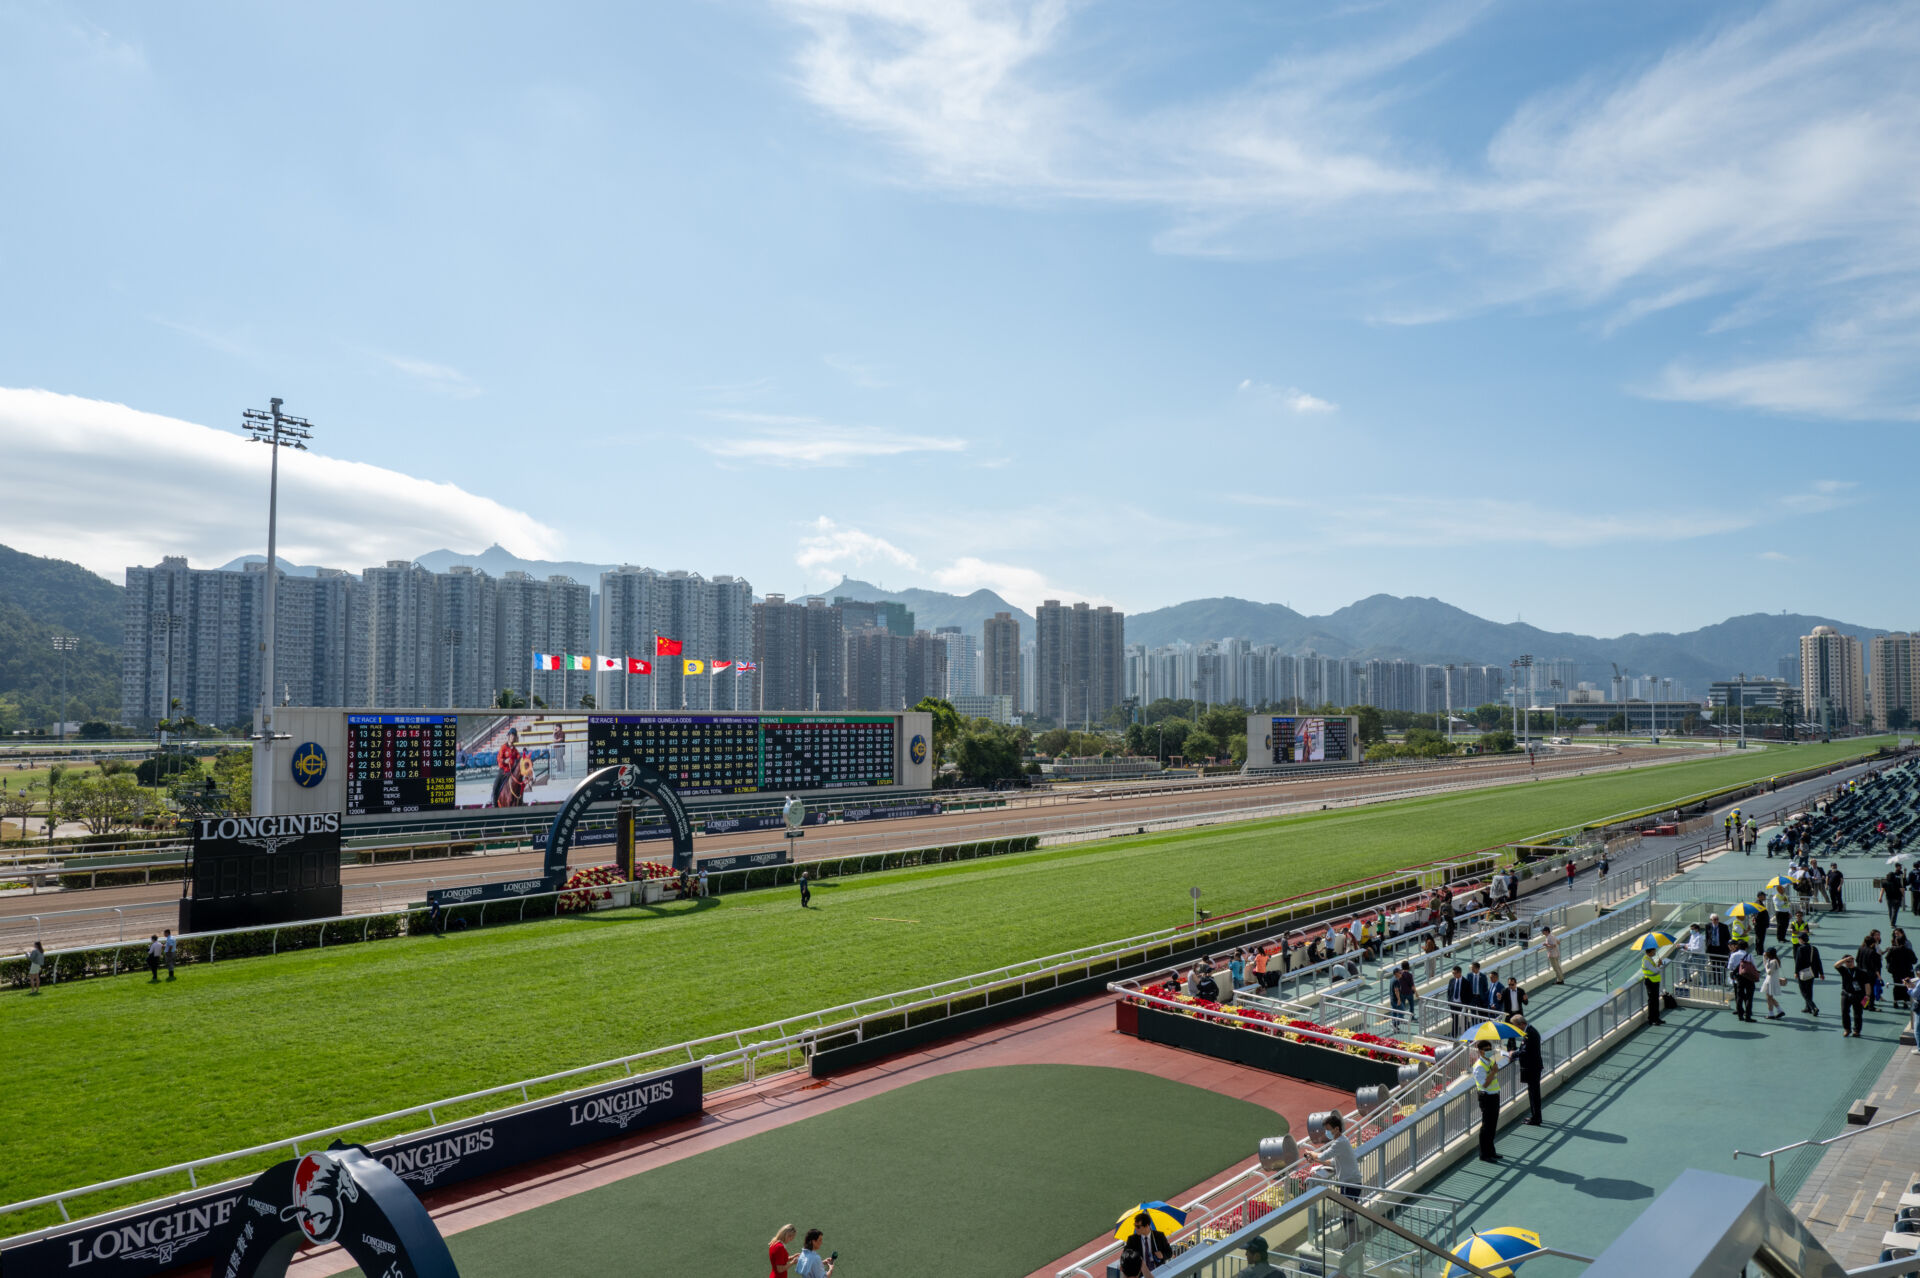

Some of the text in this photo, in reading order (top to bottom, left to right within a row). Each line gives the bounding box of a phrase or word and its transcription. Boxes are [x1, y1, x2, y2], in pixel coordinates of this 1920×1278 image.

[200, 813, 339, 841] LONGINES
[707, 820, 740, 828] LONGINES
[708, 858, 736, 868] LONGINES
[751, 854, 778, 863] LONGINES
[442, 887, 483, 899] LONGINES
[503, 880, 541, 892] LONGINES
[570, 1080, 674, 1126] LONGINES
[380, 1128, 494, 1174] ONGINES
[248, 1198, 277, 1214] LONGINES
[68, 1195, 243, 1268] LONGINE
[362, 1234, 396, 1254] LONGINES
